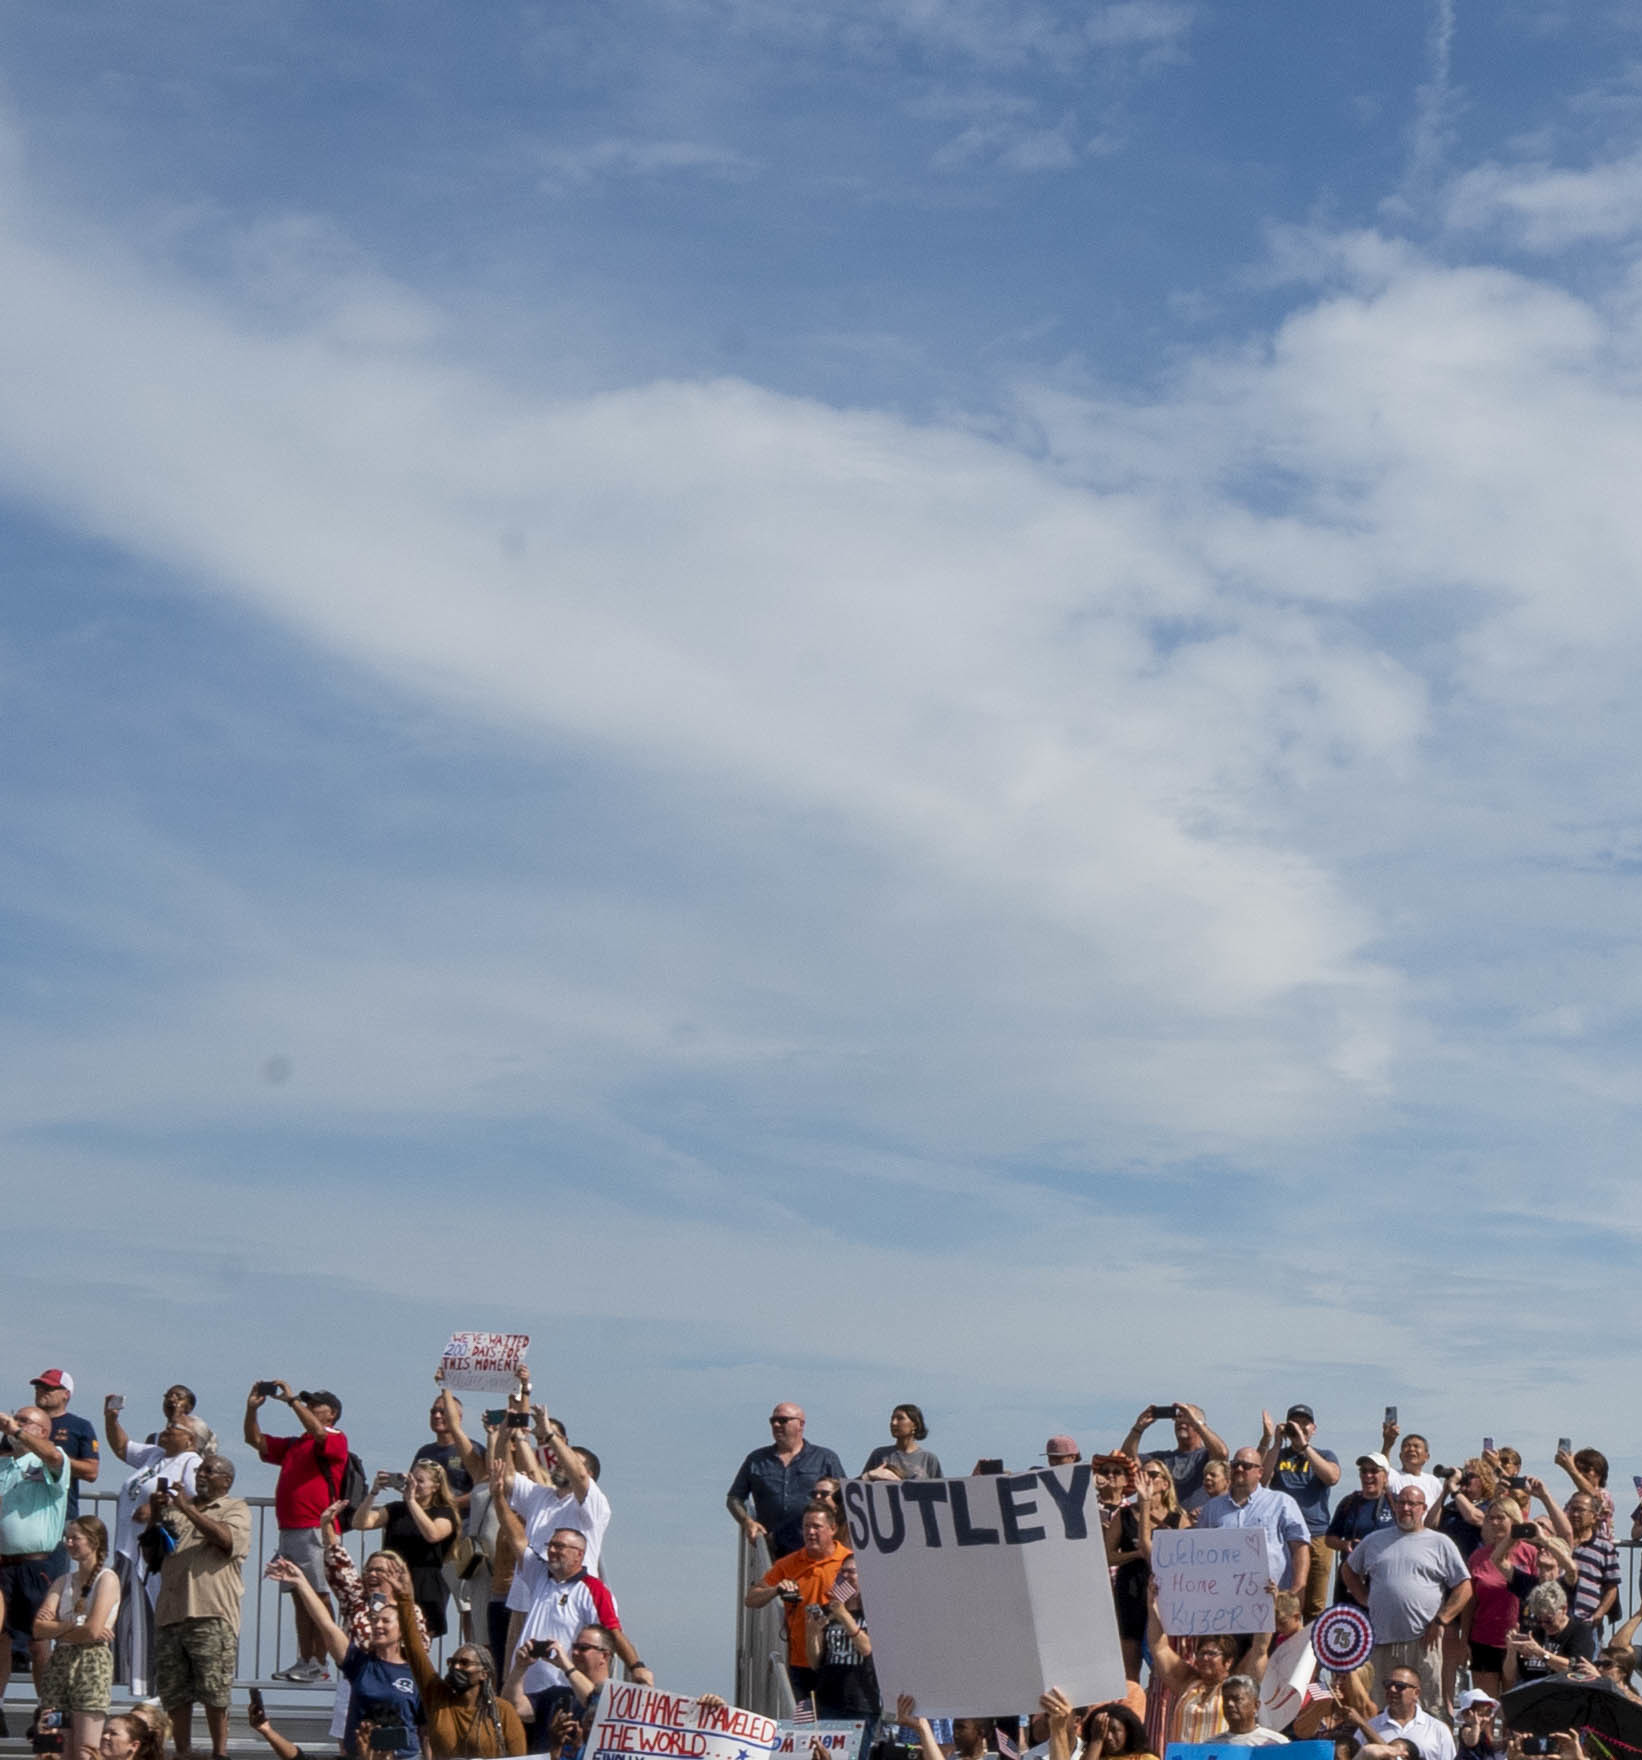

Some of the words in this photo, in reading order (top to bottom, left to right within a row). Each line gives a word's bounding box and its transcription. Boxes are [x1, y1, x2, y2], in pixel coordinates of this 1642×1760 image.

[442, 1357, 470, 1370] THIS
[475, 1359, 519, 1372] MOMENT
[472, 1346, 496, 1358] DAYS
[845, 1464, 1093, 1554] SUTLEY
[1232, 1571, 1259, 1597] 75
[1331, 1627, 1353, 1648] 75
[607, 1684, 642, 1719] YOU
[642, 1692, 689, 1727] HAVE
[697, 1700, 777, 1743] TRAVELED
[597, 1723, 639, 1752] THE
